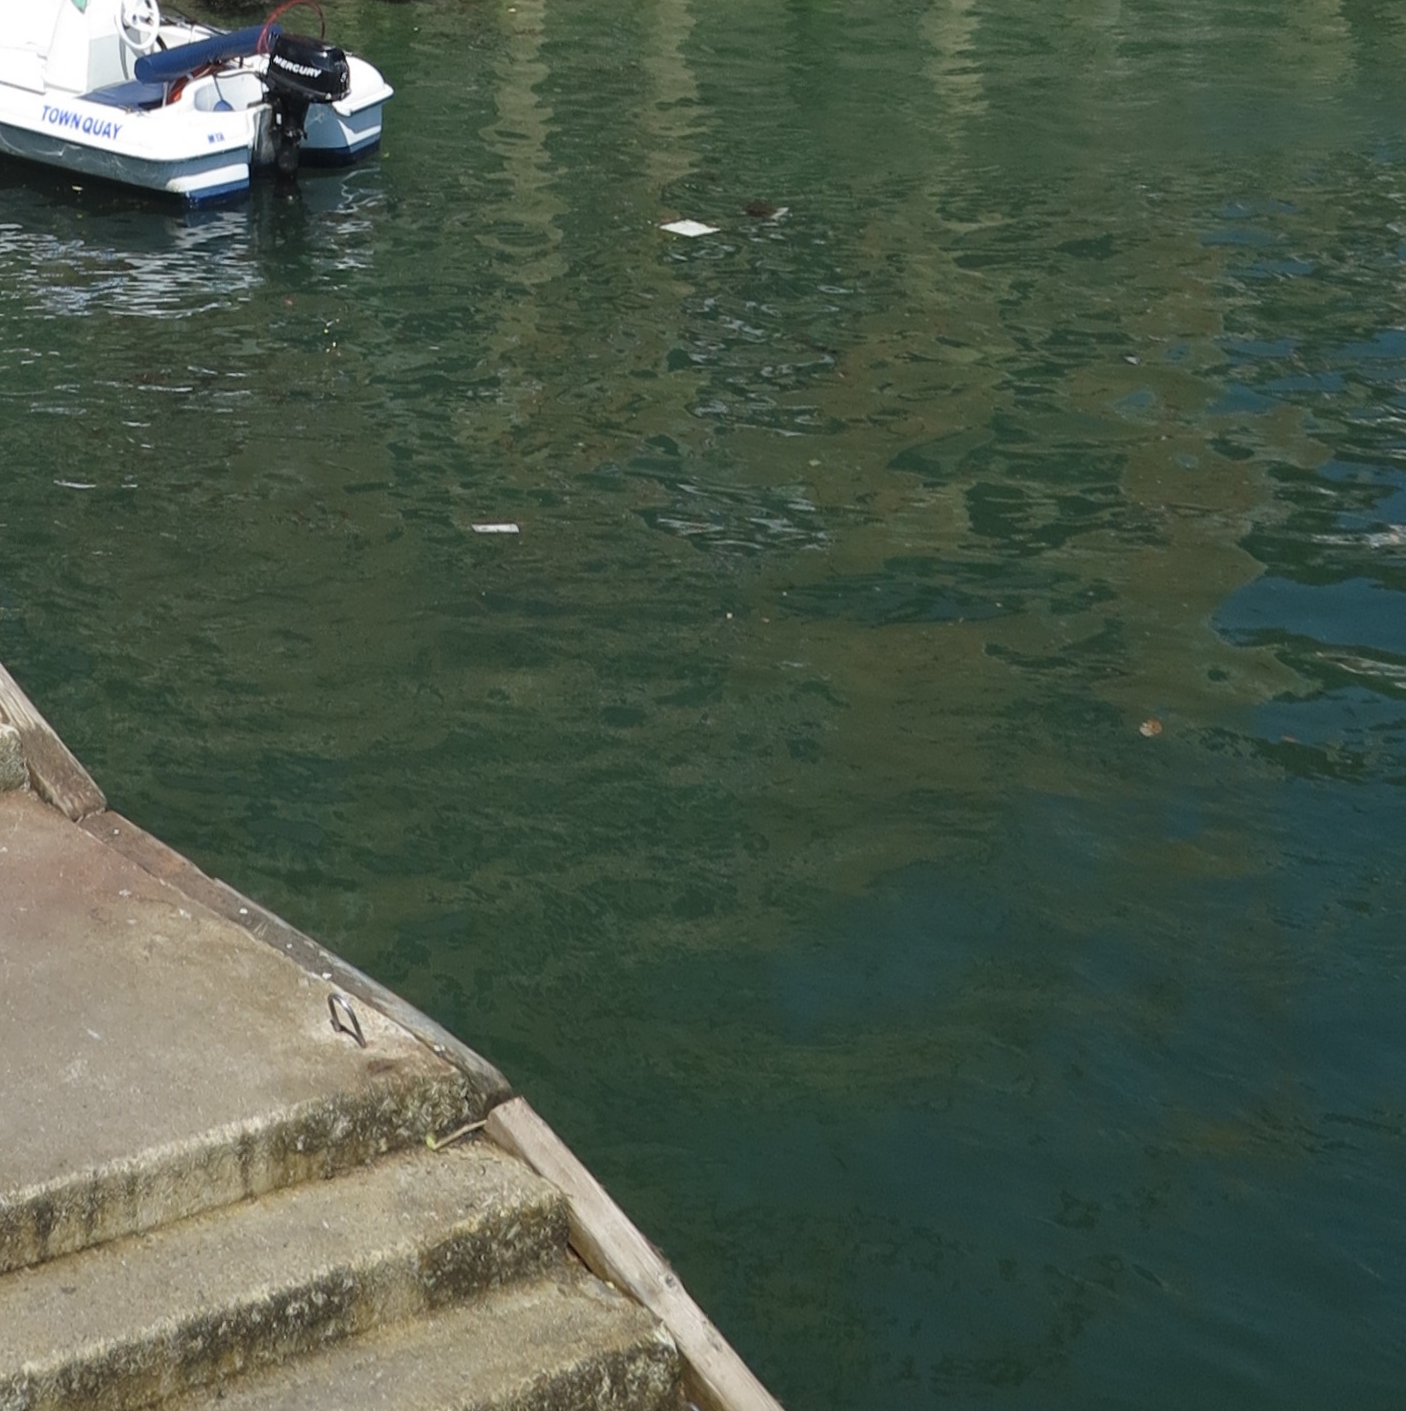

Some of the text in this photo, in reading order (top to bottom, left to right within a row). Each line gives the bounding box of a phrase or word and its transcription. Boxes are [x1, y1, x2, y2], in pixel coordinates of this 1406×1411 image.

[274, 55, 322, 78] MERCURY
[41, 105, 123, 140] TOWN QUAY
